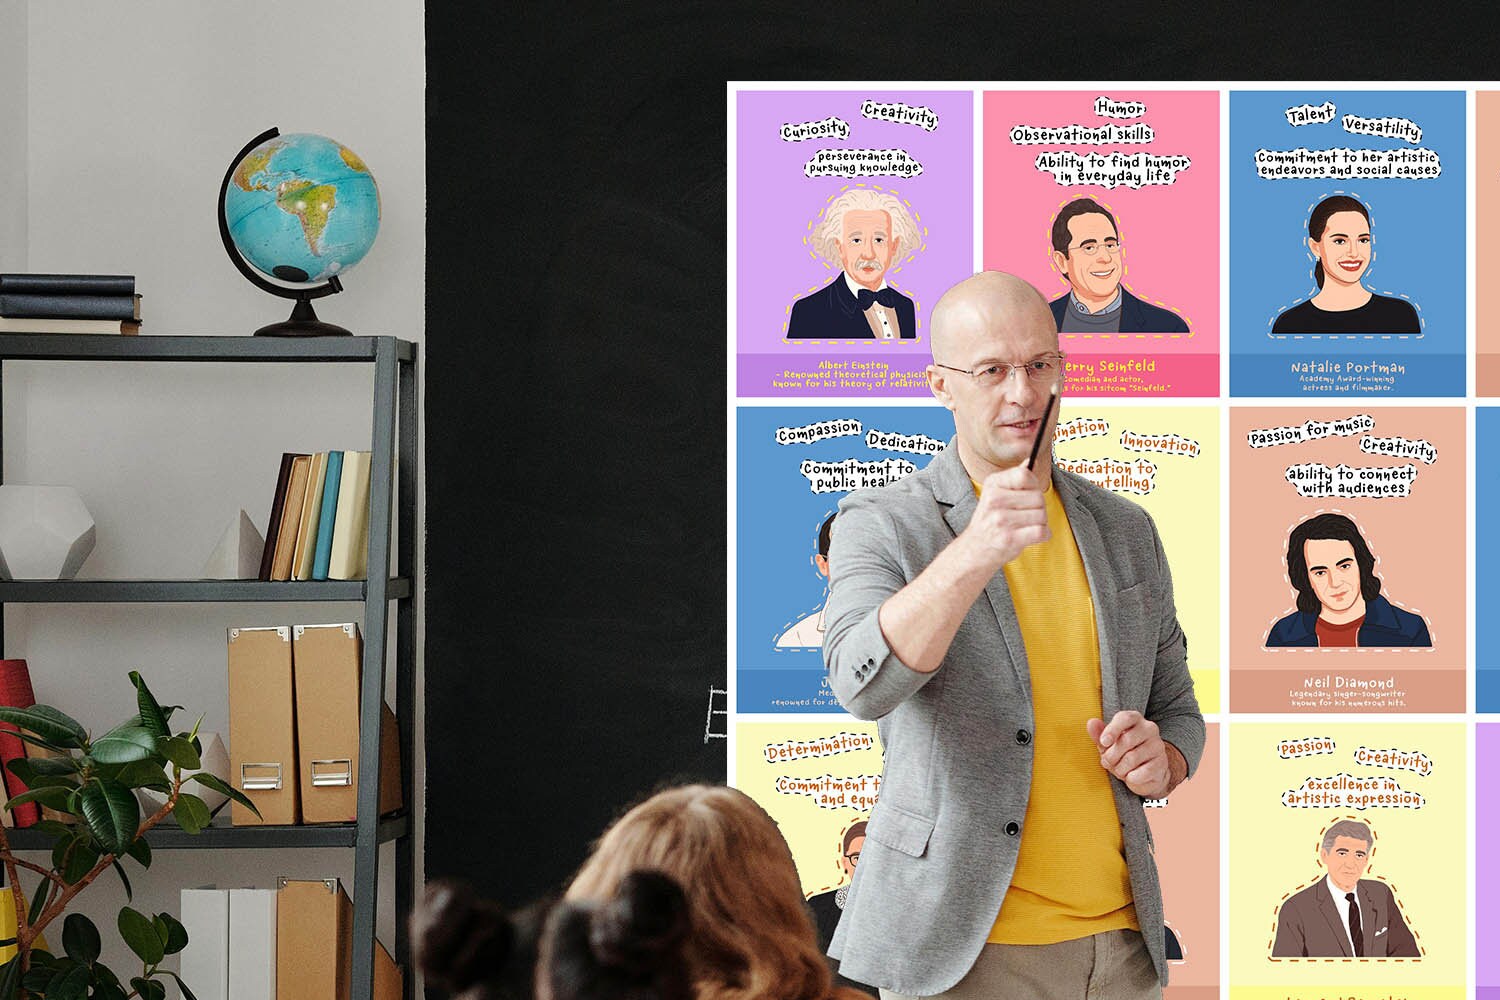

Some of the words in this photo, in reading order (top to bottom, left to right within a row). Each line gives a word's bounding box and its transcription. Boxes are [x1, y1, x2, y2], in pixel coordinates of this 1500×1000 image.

[1098, 100, 1142, 115] Humor
[1289, 105, 1333, 123] Talent
[865, 103, 935, 128] Creativity
[784, 120, 846, 137] Curiosity
[1013, 127, 1112, 142] Observational
[1117, 127, 1151, 140] skills
[1345, 118, 1418, 141] Versatility
[818, 153, 893, 163] perseverance
[897, 153, 906, 161] in
[1038, 155, 1084, 171] Ability
[1089, 156, 1105, 167] to
[1111, 155, 1140, 168] find
[1145, 156, 1188, 169] humor
[1258, 151, 1338, 164] Commitment
[1342, 152, 1357, 162] to
[1362, 152, 1382, 162] her
[1387, 151, 1435, 162] artistic
[810, 164, 856, 174] pursuing
[860, 162, 919, 174] knowledge
[1261, 165, 1325, 176] endeavors
[1330, 164, 1351, 176] and
[1357, 164, 1391, 174] social
[1397, 166, 1437, 176] causes
[1061, 171, 1071, 181] in
[1078, 170, 1141, 185] everyday
[1146, 169, 1170, 181] life
[818, 361, 848, 369] Albert
[852, 362, 889, 370] Einstein
[1065, 360, 1095, 376] erry
[1100, 359, 1155, 373] Seinfeld
[1291, 360, 1340, 373] Natalie
[1346, 361, 1405, 374] Portman
[779, 422, 859, 442] Compassion
[1307, 424, 1329, 436] for
[1334, 419, 1371, 433] music
[869, 433, 944, 452] Dedication
[1124, 434, 1196, 453] Innovation
[1363, 439, 1433, 461] Creativity
[804, 462, 892, 475] Commitment
[898, 462, 913, 474] to
[1137, 462, 1153, 474] to
[1289, 467, 1332, 483] ability
[1338, 468, 1354, 479] to
[1359, 468, 1414, 480] connect
[817, 475, 856, 489] public
[1303, 482, 1332, 493] with
[1338, 483, 1404, 493] audiences
[1304, 675, 1330, 688] Neil
[1335, 676, 1394, 690] Diamond
[768, 736, 868, 759] Determination
[1358, 751, 1428, 772] Creativity
[780, 778, 868, 792] Commitment
[1308, 778, 1379, 791] excellence
[1384, 780, 1395, 791] in
[821, 793, 845, 805] and
[1288, 792, 1341, 804] artistic
[1347, 794, 1420, 806] expression
